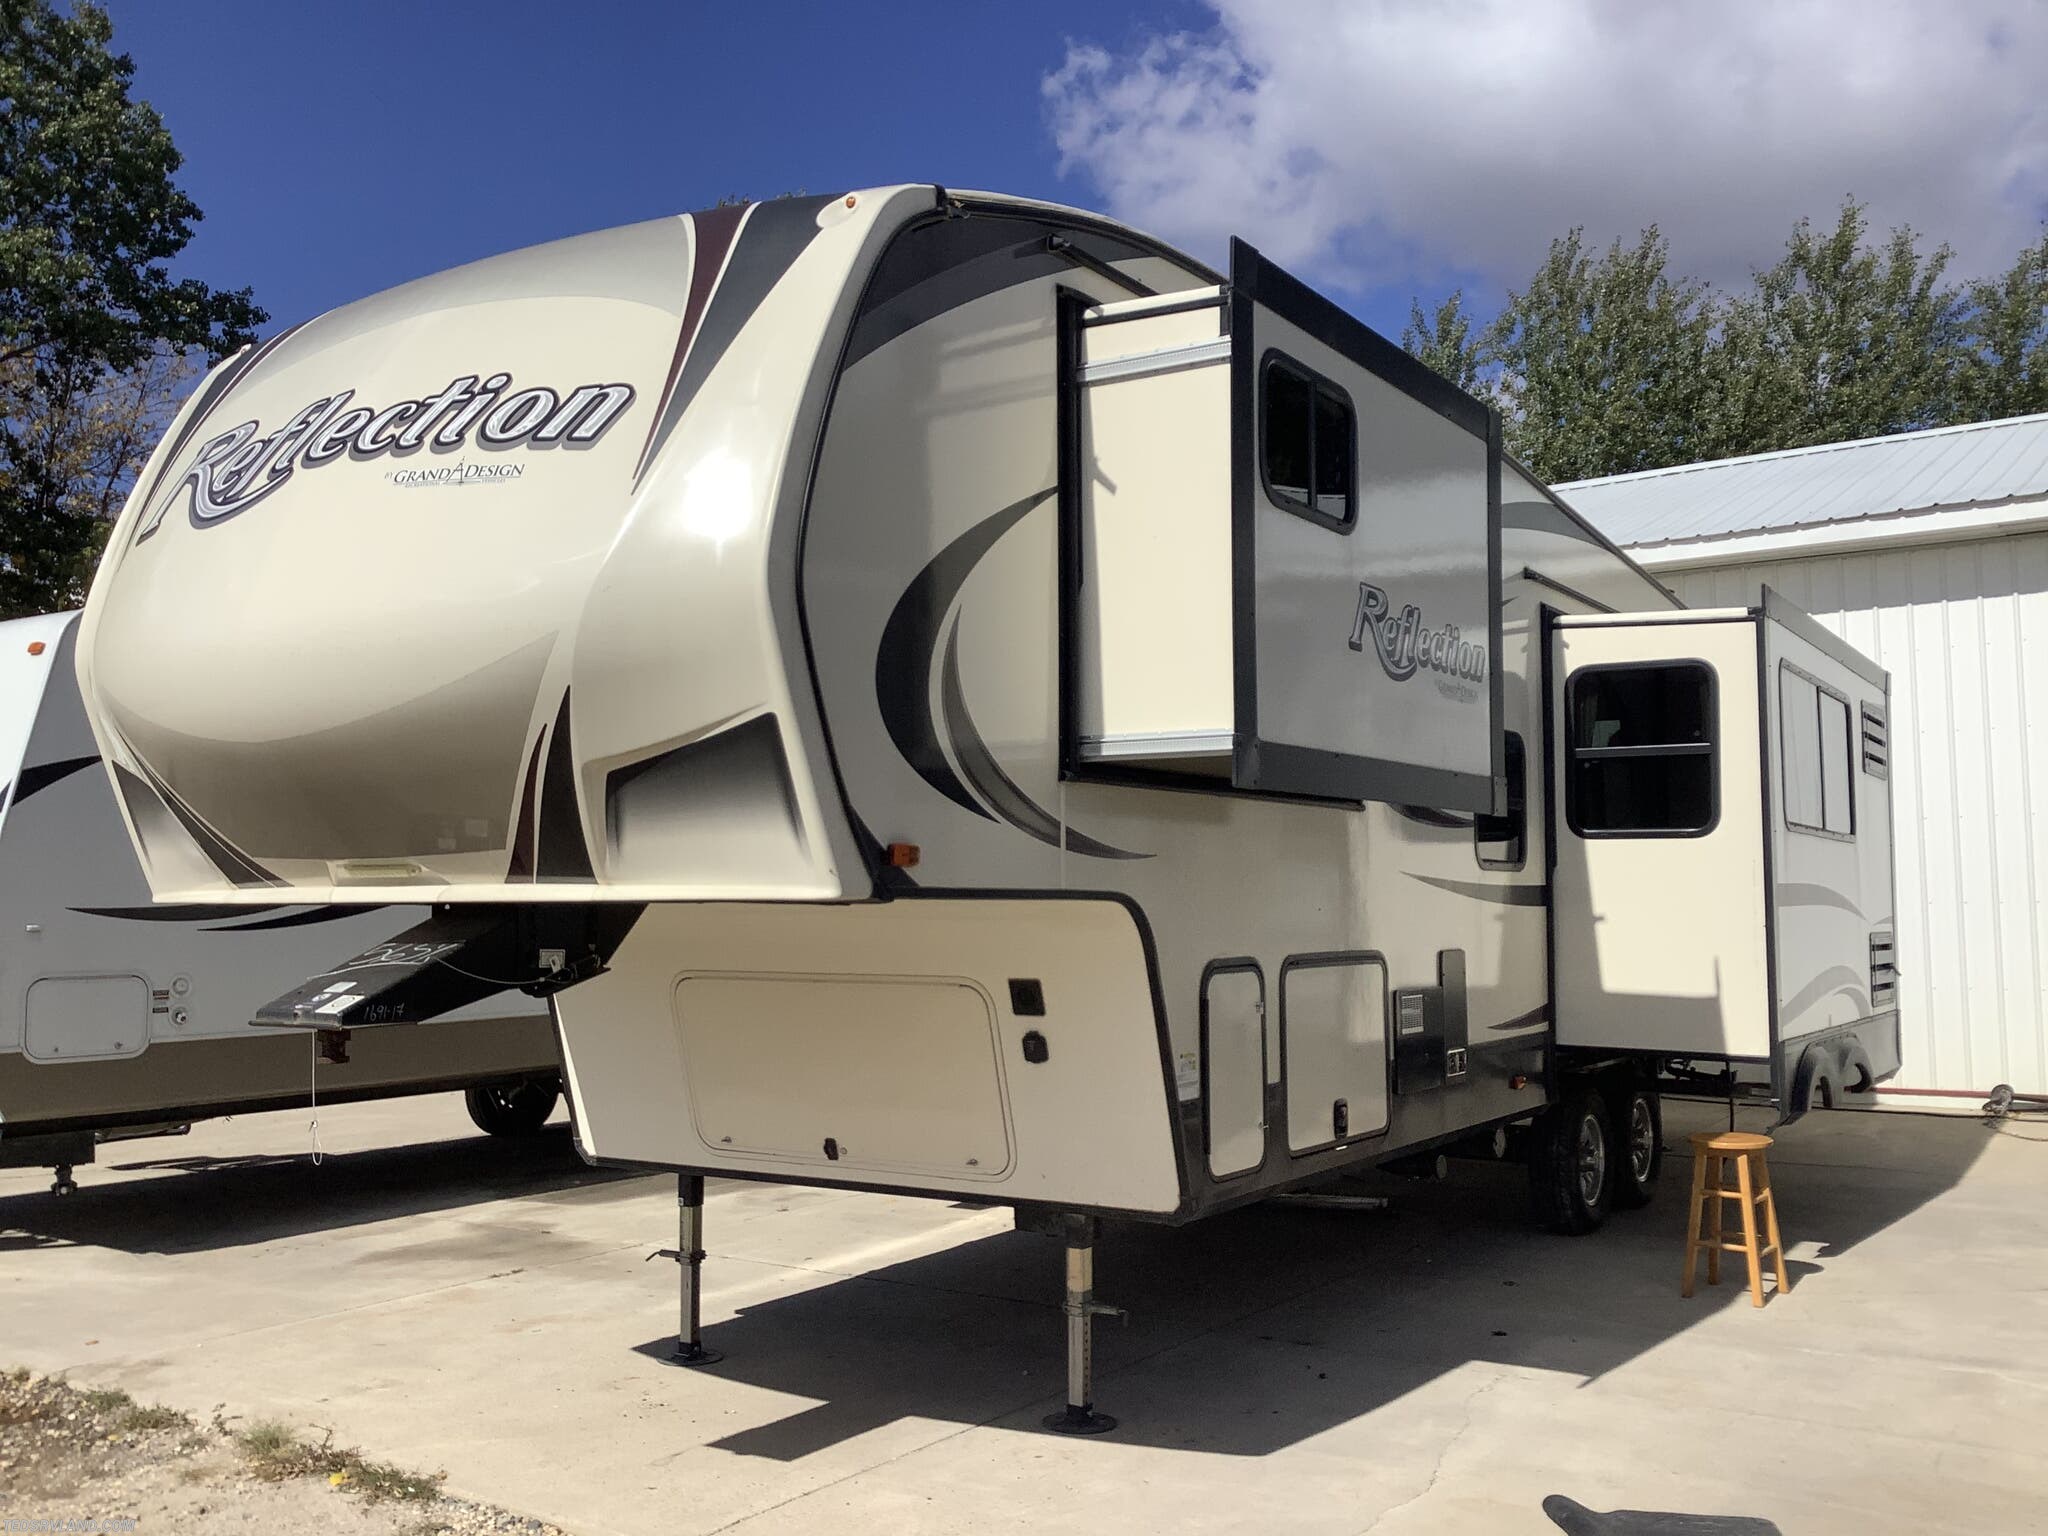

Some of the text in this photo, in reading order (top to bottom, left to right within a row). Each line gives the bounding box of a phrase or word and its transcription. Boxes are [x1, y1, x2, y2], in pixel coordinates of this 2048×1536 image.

[136, 373, 636, 546] Reflection
[394, 468, 451, 483] GRAND
[464, 464, 525, 478] DESIGN
[1349, 581, 1485, 682] Reflection
